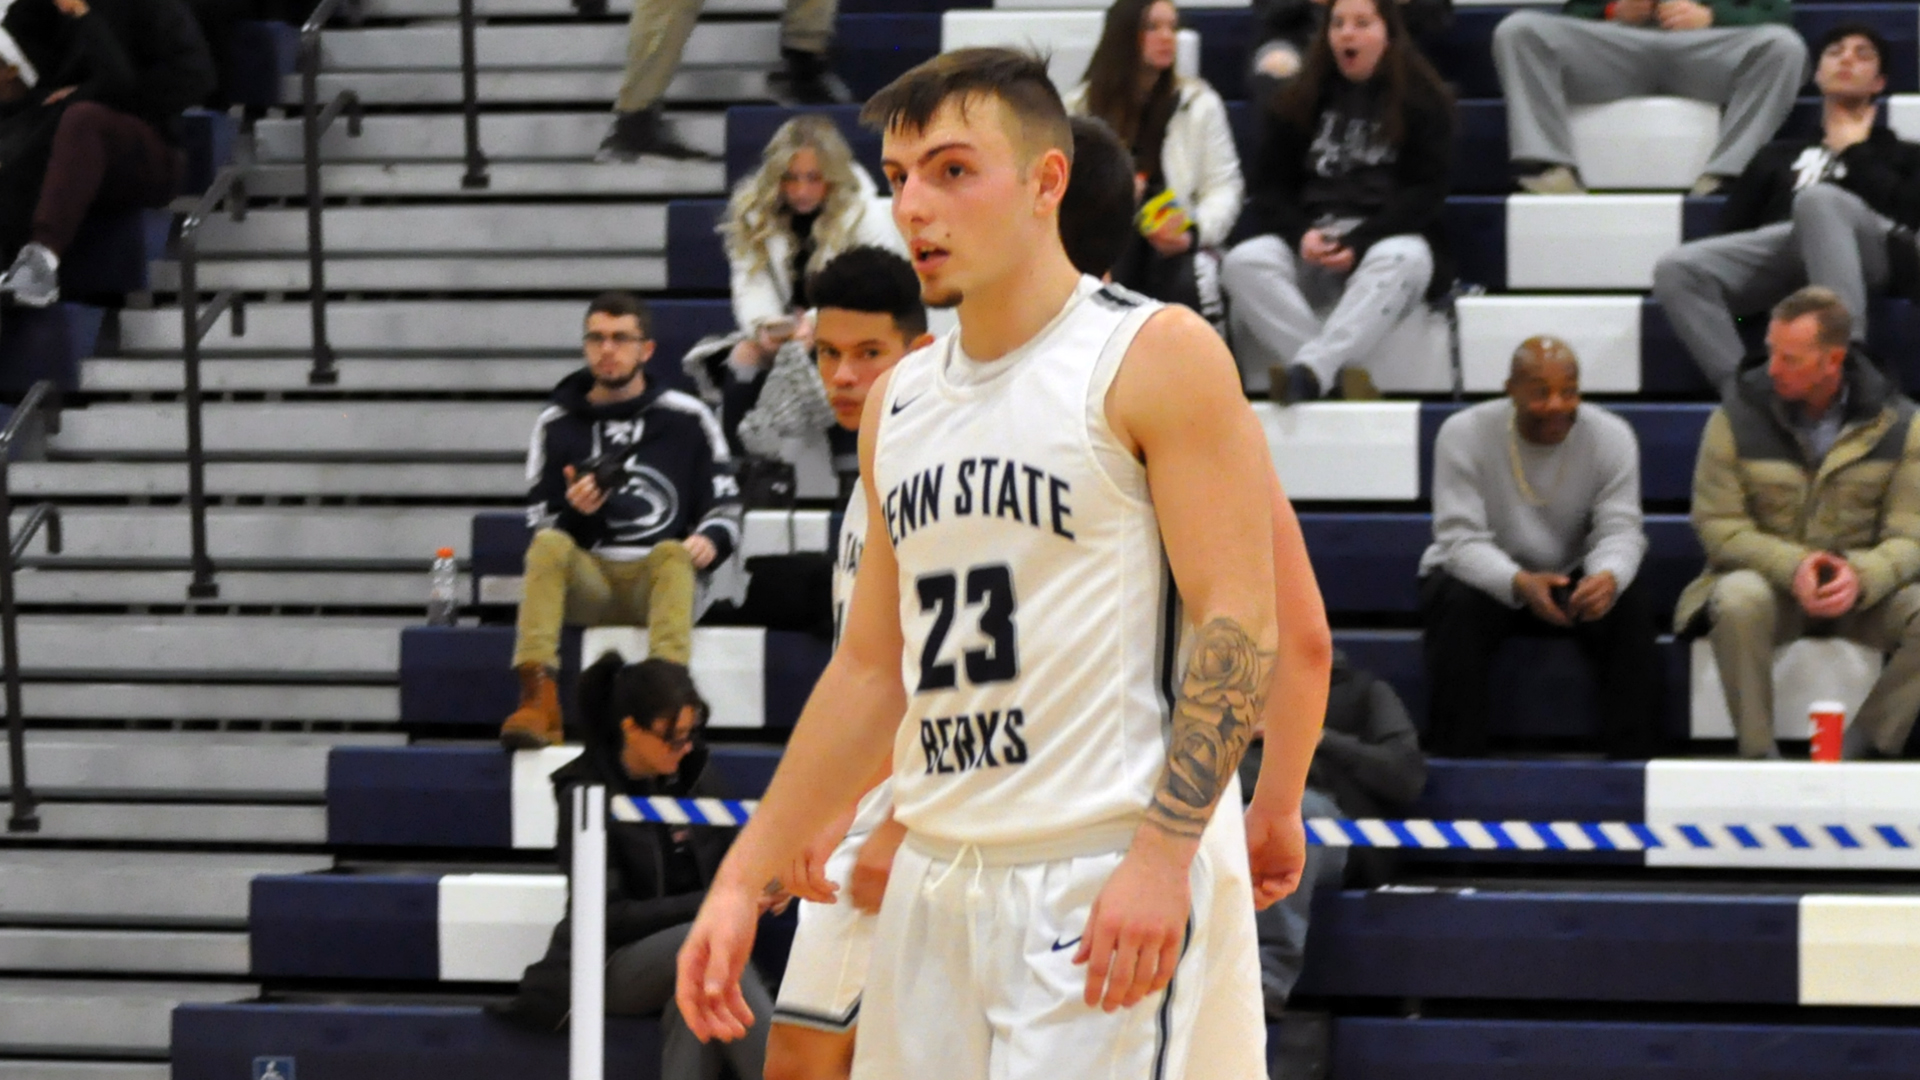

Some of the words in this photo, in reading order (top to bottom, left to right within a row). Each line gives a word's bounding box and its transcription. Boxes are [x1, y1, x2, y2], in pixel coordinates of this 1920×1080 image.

[882, 463, 945, 549] ENN
[955, 457, 1075, 541] STATE
[915, 563, 1019, 694] 23
